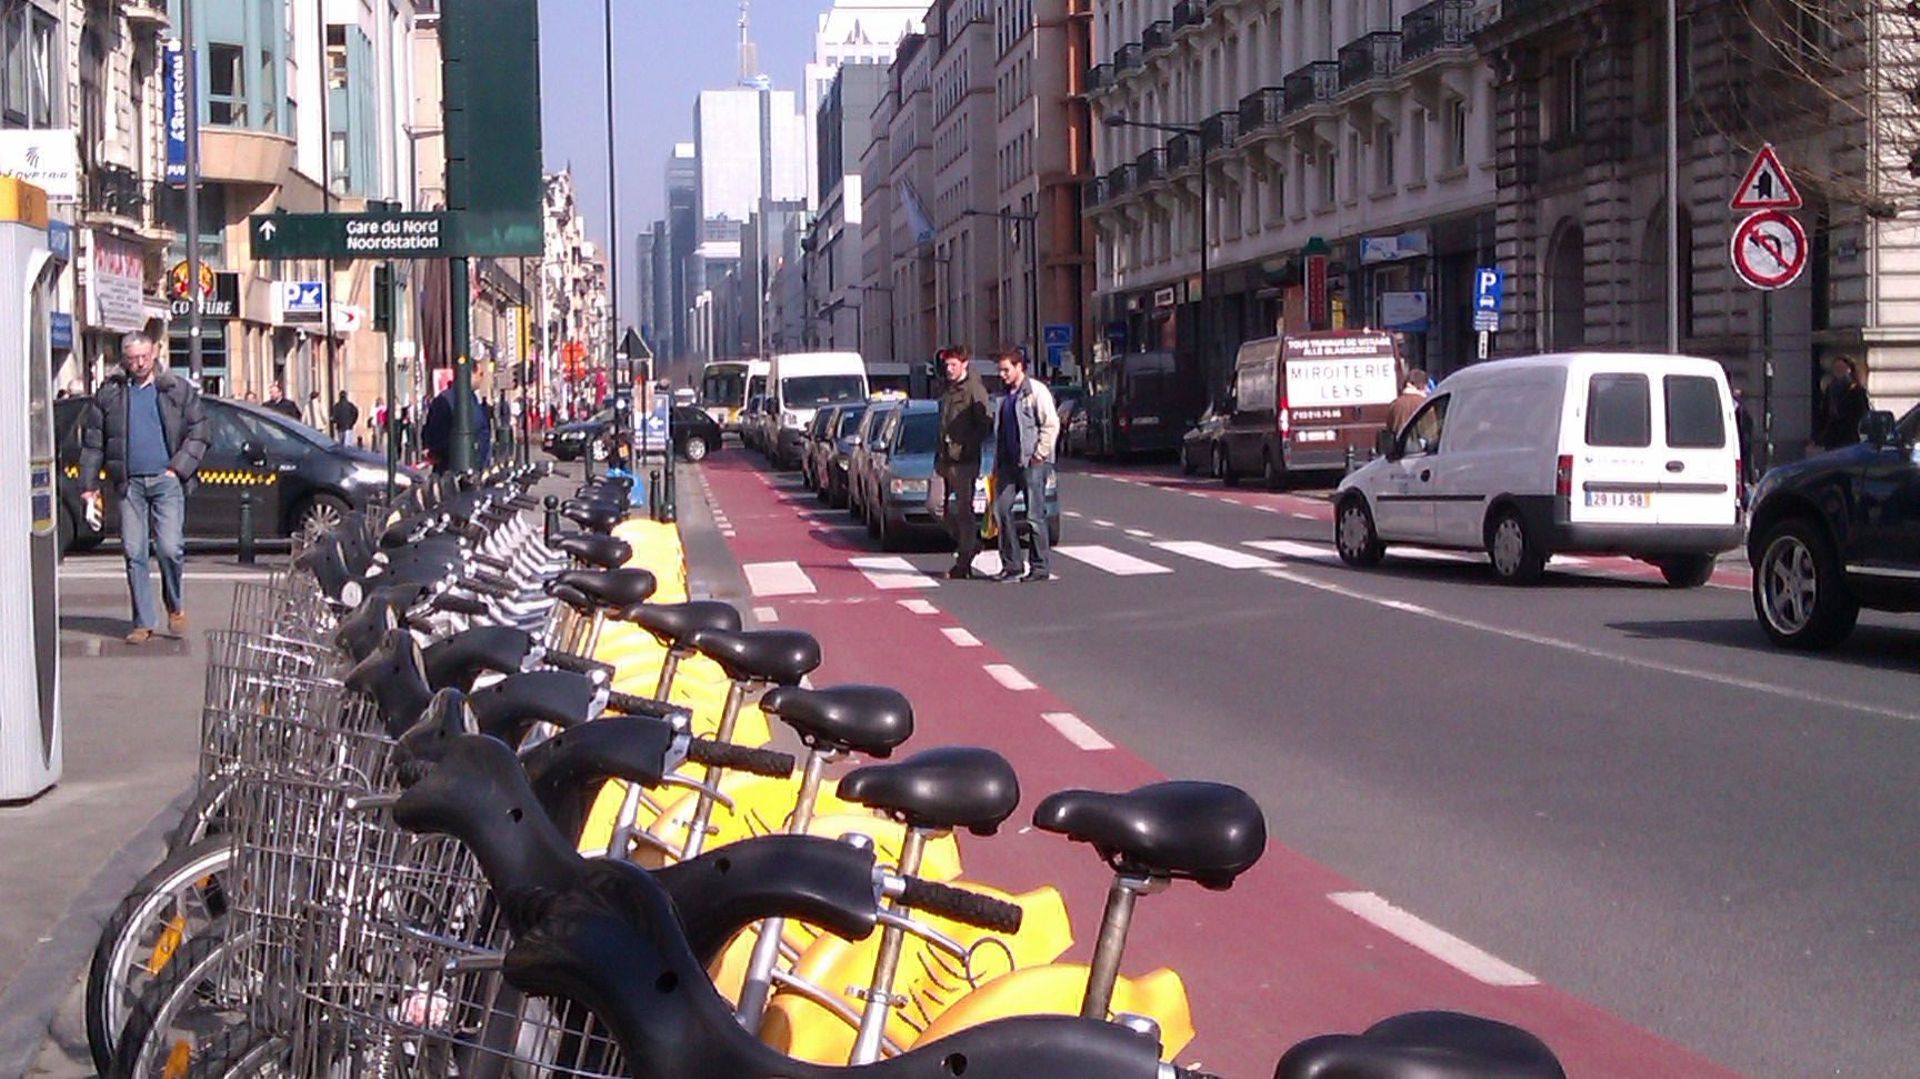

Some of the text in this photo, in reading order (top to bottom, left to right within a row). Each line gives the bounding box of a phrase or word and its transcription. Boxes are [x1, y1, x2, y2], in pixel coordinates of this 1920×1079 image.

[346, 219, 439, 235] Gare du Nord
[346, 235, 439, 250] Noordstation
[1480, 271, 1498, 295] P
[1291, 364, 1390, 380] MIROITERIE
[1321, 384, 1363, 399] LEYS
